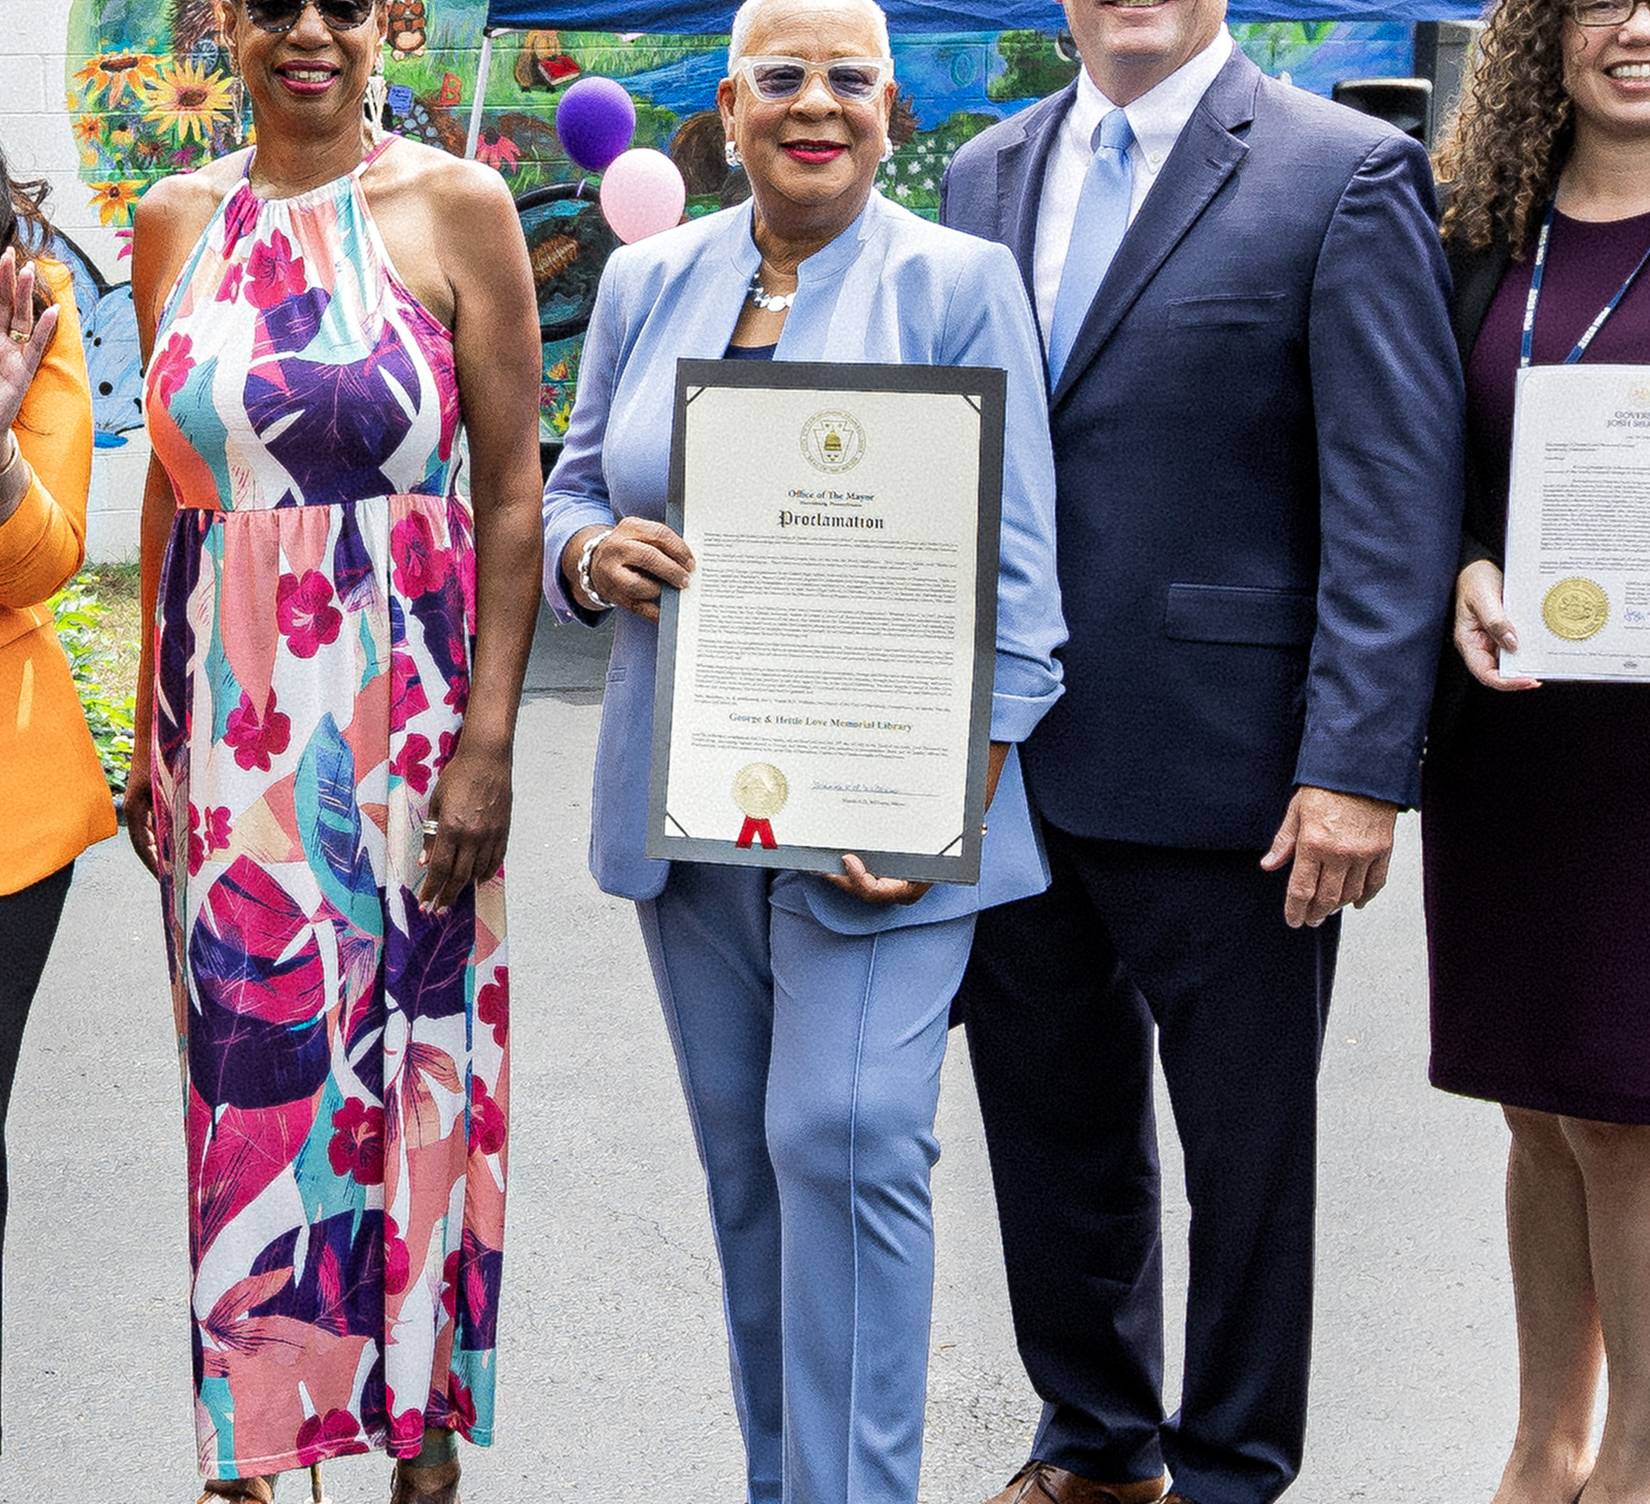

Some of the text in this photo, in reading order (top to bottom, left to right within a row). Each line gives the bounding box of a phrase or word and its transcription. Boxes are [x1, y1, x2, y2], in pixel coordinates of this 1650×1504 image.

[439, 72, 463, 106] B
[776, 509, 884, 529] Proclamation
[728, 712, 763, 725] George
[805, 716, 828, 728] Love
[829, 718, 875, 730] Memorial
[876, 720, 914, 734] Library
